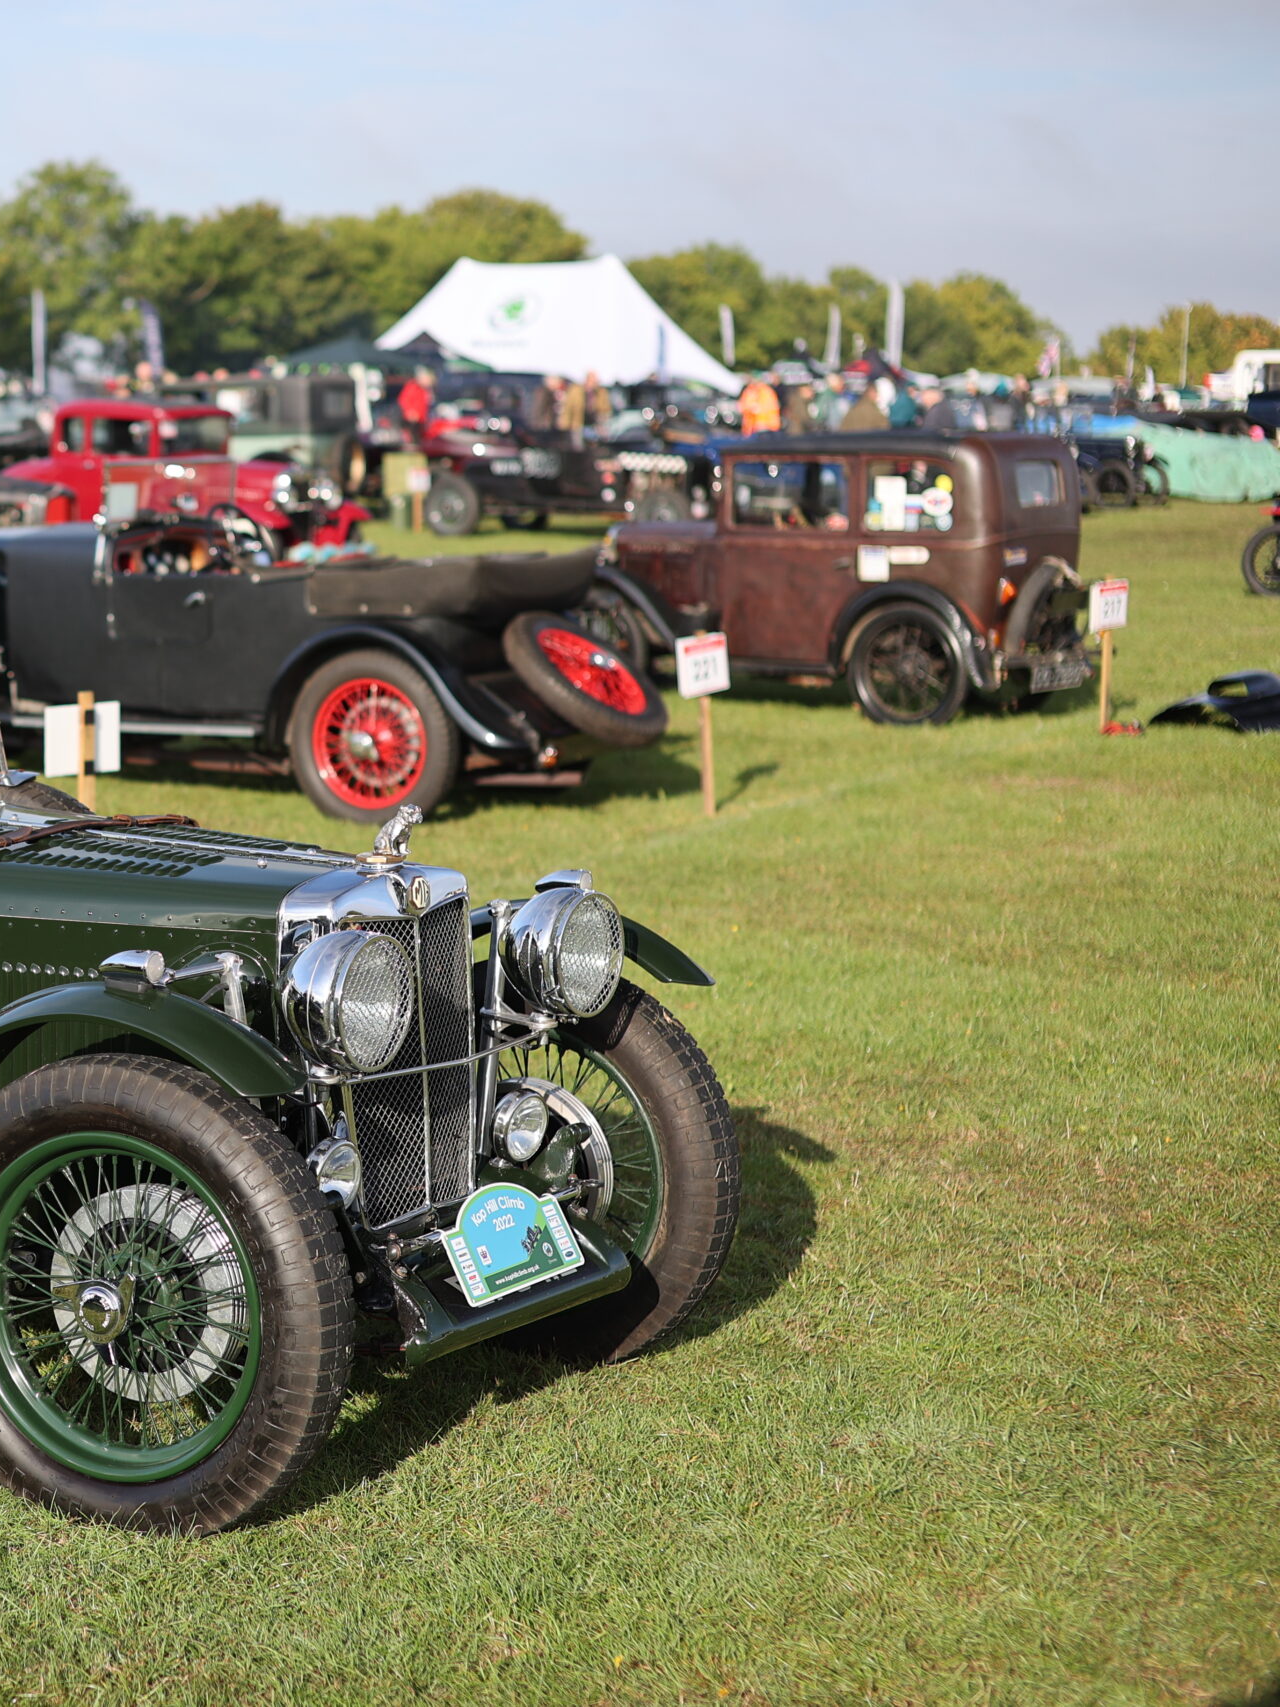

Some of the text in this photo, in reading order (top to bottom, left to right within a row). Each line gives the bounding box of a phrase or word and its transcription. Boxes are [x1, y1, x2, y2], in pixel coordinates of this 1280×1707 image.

[694, 656, 718, 681] 221
[471, 1195, 525, 1227] Kop Hill Climb
[493, 1213, 515, 1232] 2022
